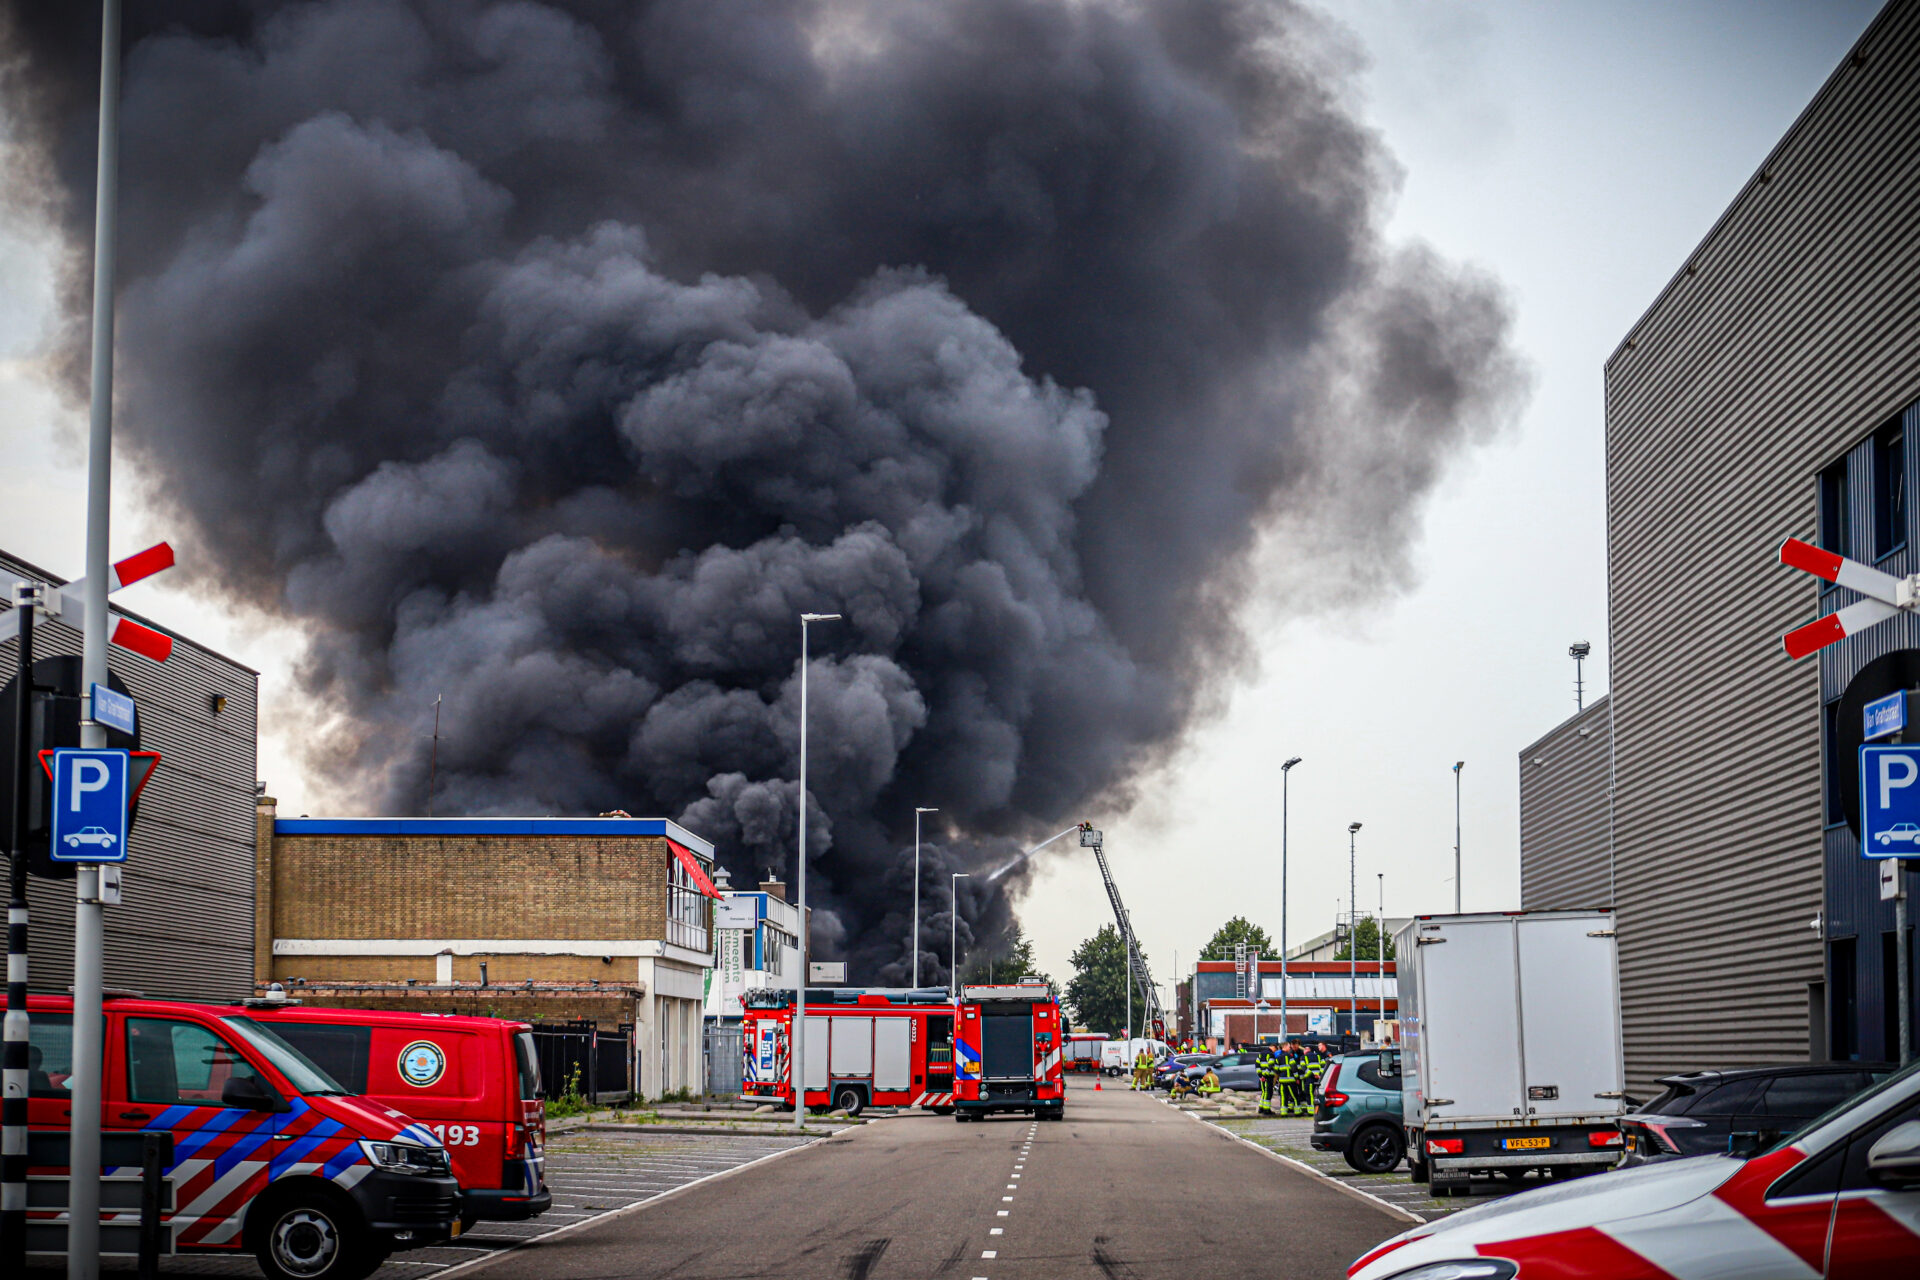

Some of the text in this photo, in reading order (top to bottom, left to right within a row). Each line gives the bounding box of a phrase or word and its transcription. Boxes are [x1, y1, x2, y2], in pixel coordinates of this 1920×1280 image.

[71, 758, 110, 812] P
[1879, 754, 1918, 809] P
[732, 929, 741, 983] emeente
[430, 1125, 480, 1147] 193
[1510, 1138, 1547, 1148] VFL-53-P
